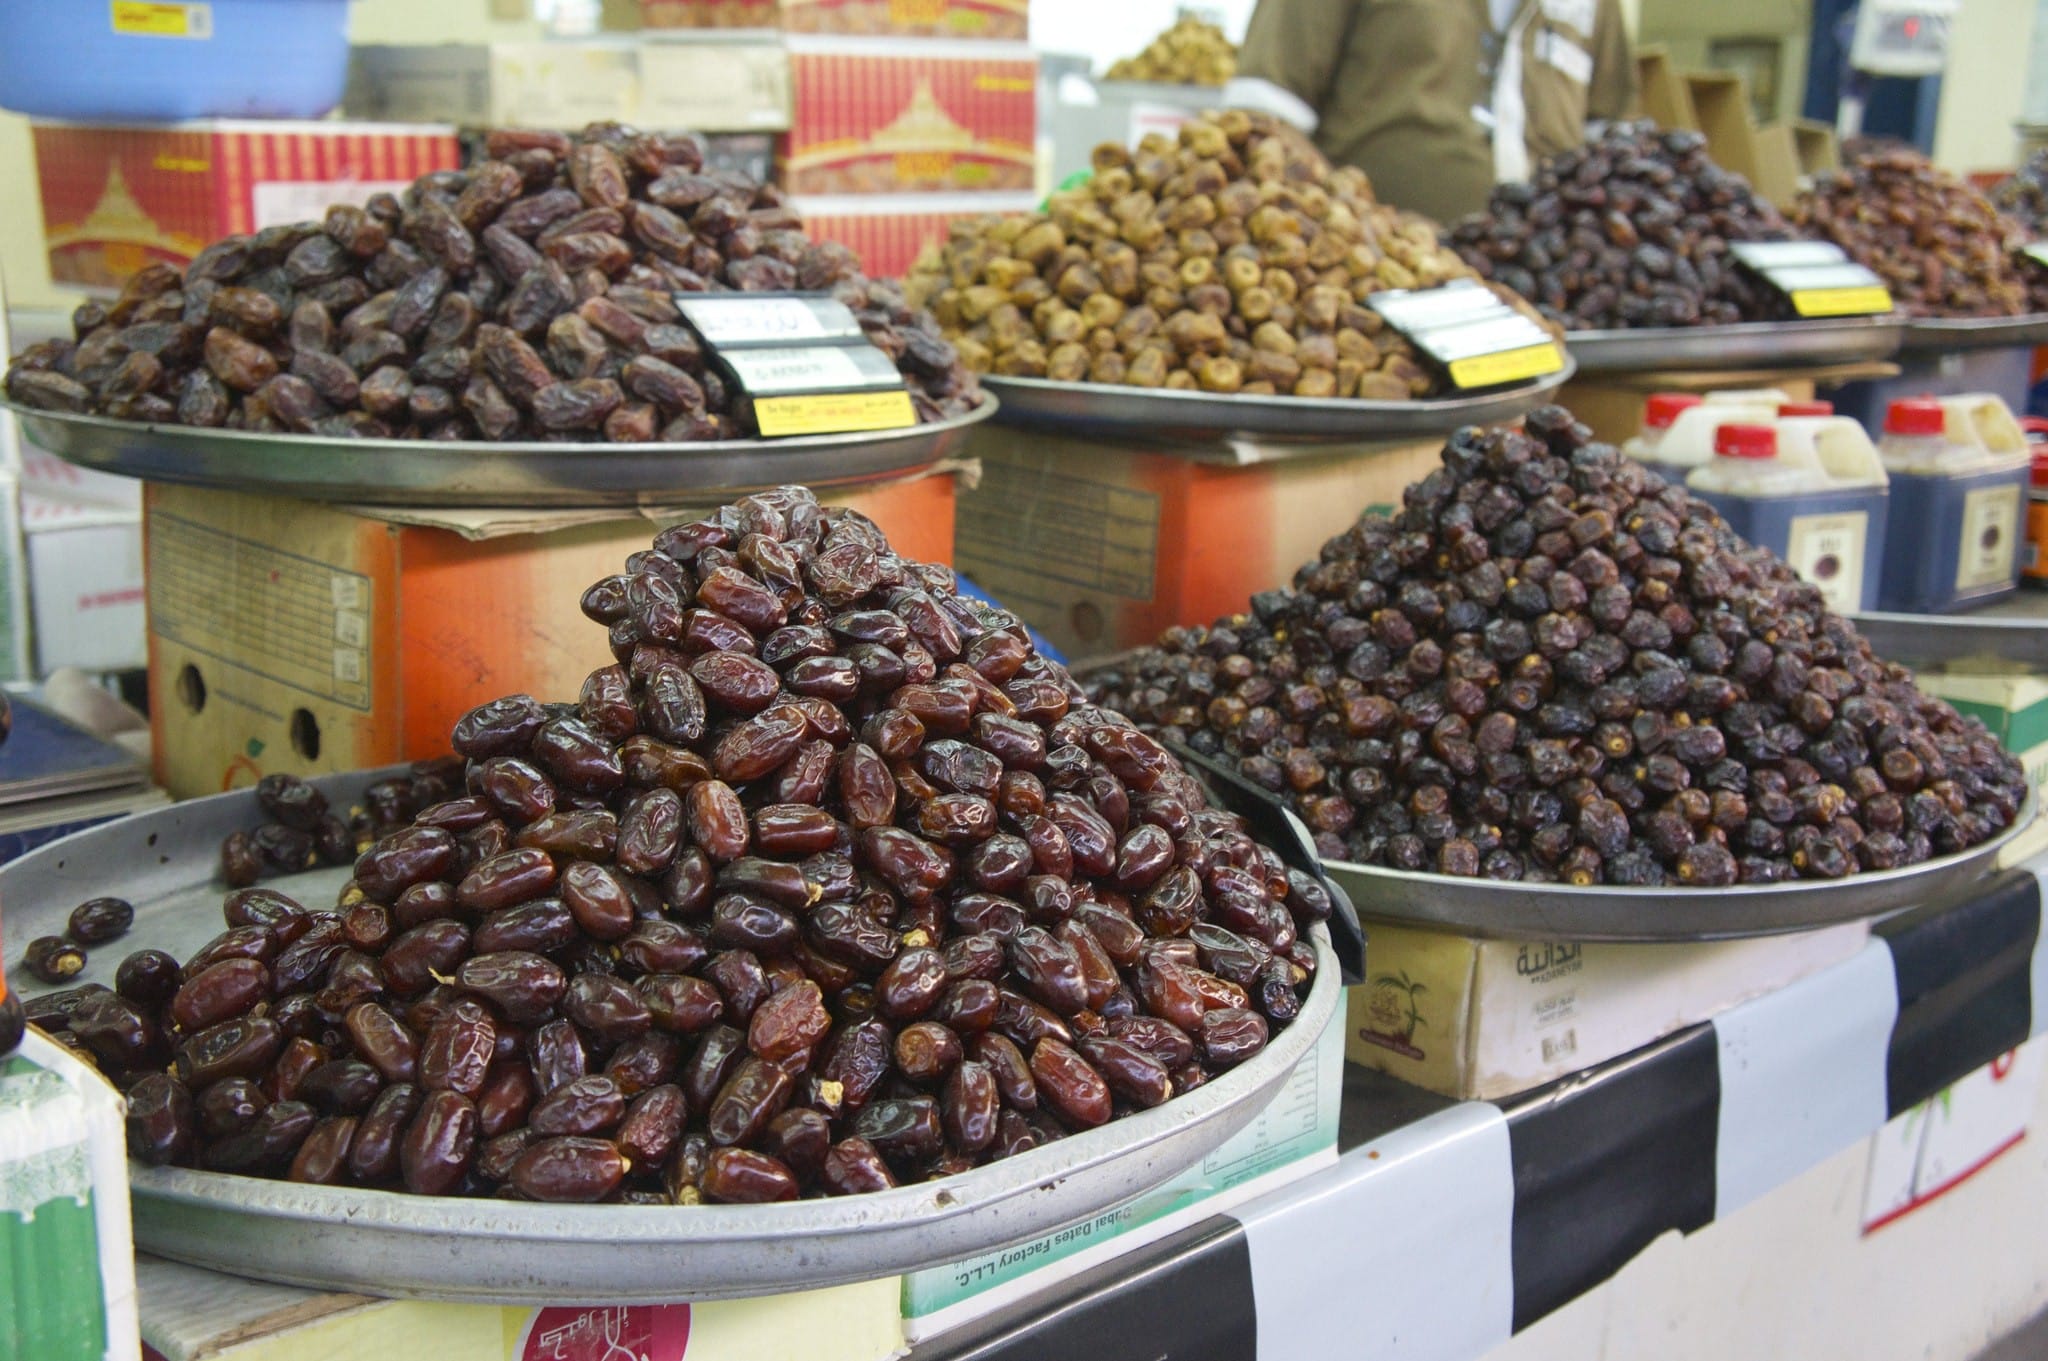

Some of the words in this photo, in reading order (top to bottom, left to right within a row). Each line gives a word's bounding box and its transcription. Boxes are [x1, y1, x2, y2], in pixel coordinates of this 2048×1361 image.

[1055, 1223, 1092, 1246] Dates
[999, 1239, 1051, 1270] Factory
[954, 1262, 996, 1287] L.L.C.
